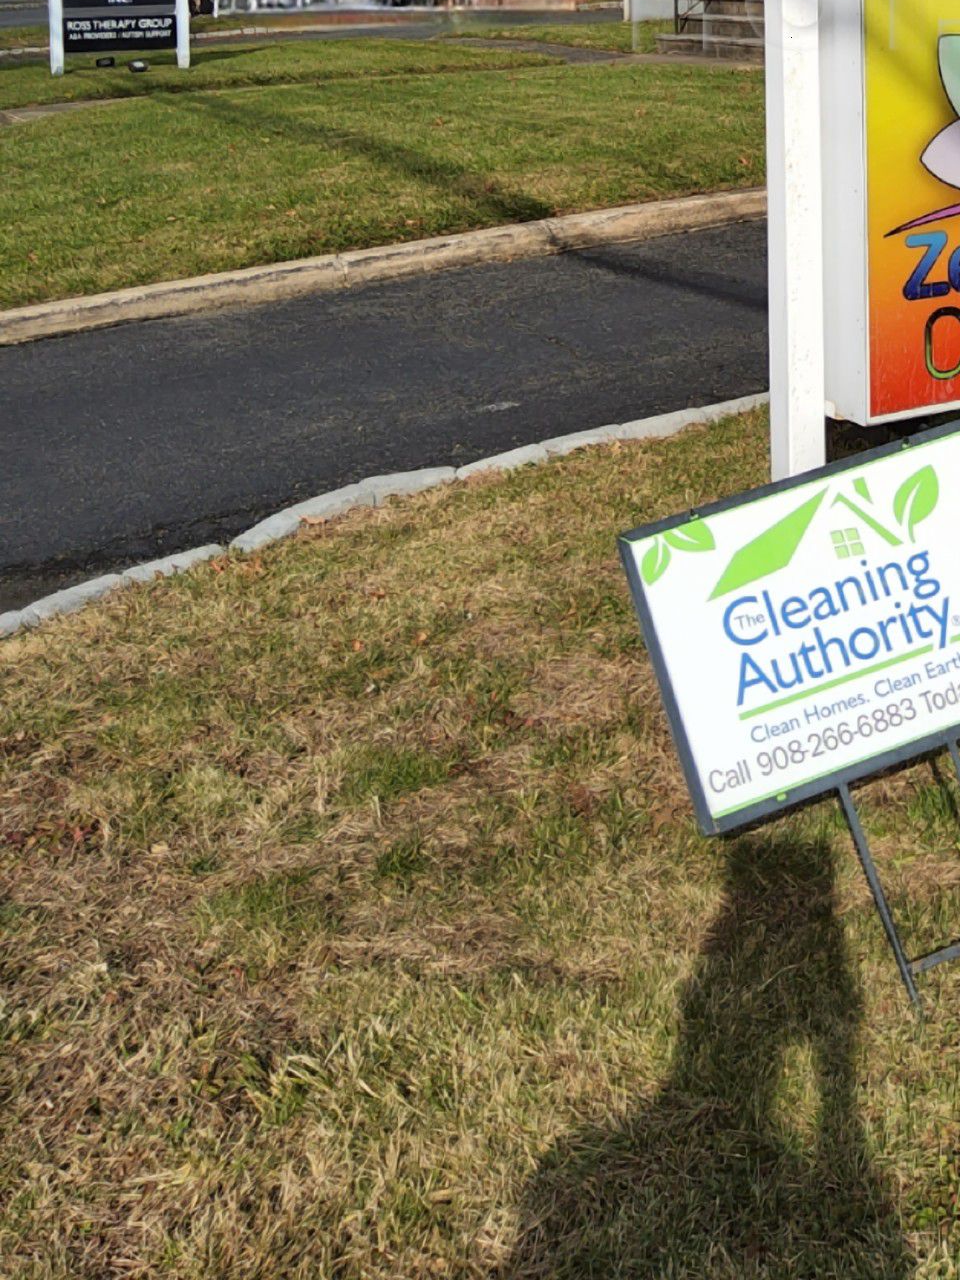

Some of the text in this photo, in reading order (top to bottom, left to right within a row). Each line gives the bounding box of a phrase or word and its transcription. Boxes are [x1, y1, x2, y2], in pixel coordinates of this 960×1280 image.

[66, 17, 172, 31] ROSS THERAPY GROUP
[722, 550, 941, 646] The Cleaning
[736, 596, 951, 707] Authority
[708, 759, 752, 794] Call
[757, 701, 917, 778] 908-266-6883
[750, 717, 801, 745] Clean
[804, 693, 870, 725] Homes.
[874, 671, 922, 698] Clean
